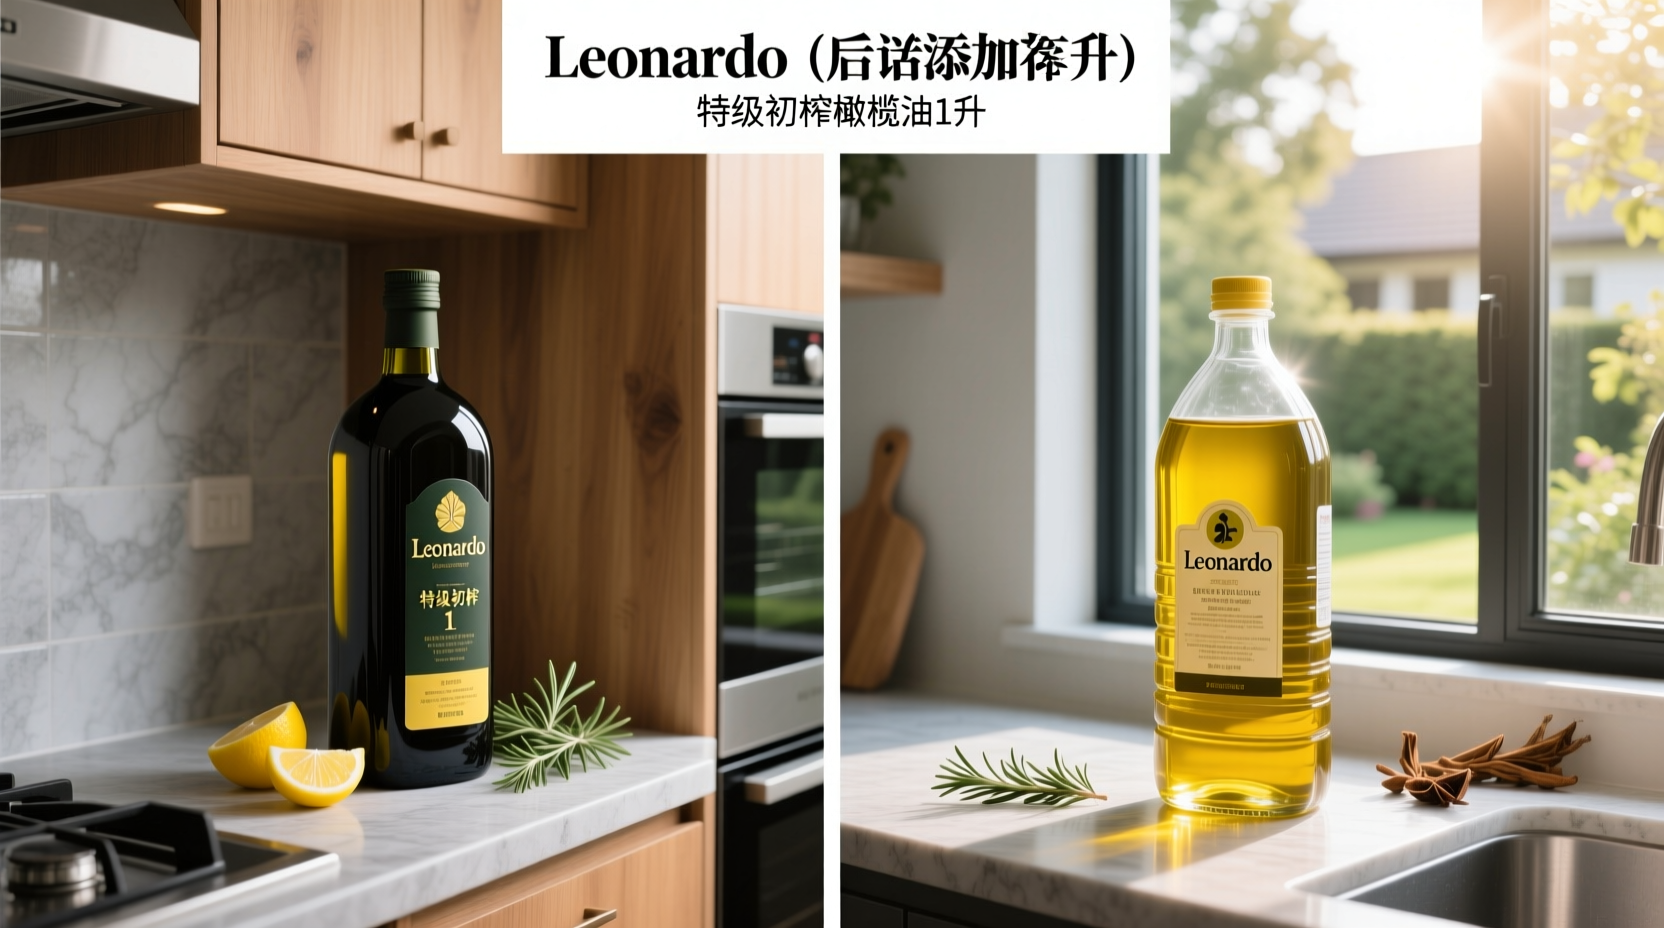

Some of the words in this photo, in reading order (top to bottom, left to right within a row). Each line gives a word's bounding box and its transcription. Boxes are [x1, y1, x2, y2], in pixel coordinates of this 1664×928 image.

[411, 535, 486, 559] Leonardo
[1184, 550, 1273, 572] Leonardo
[444, 610, 457, 631] 1
